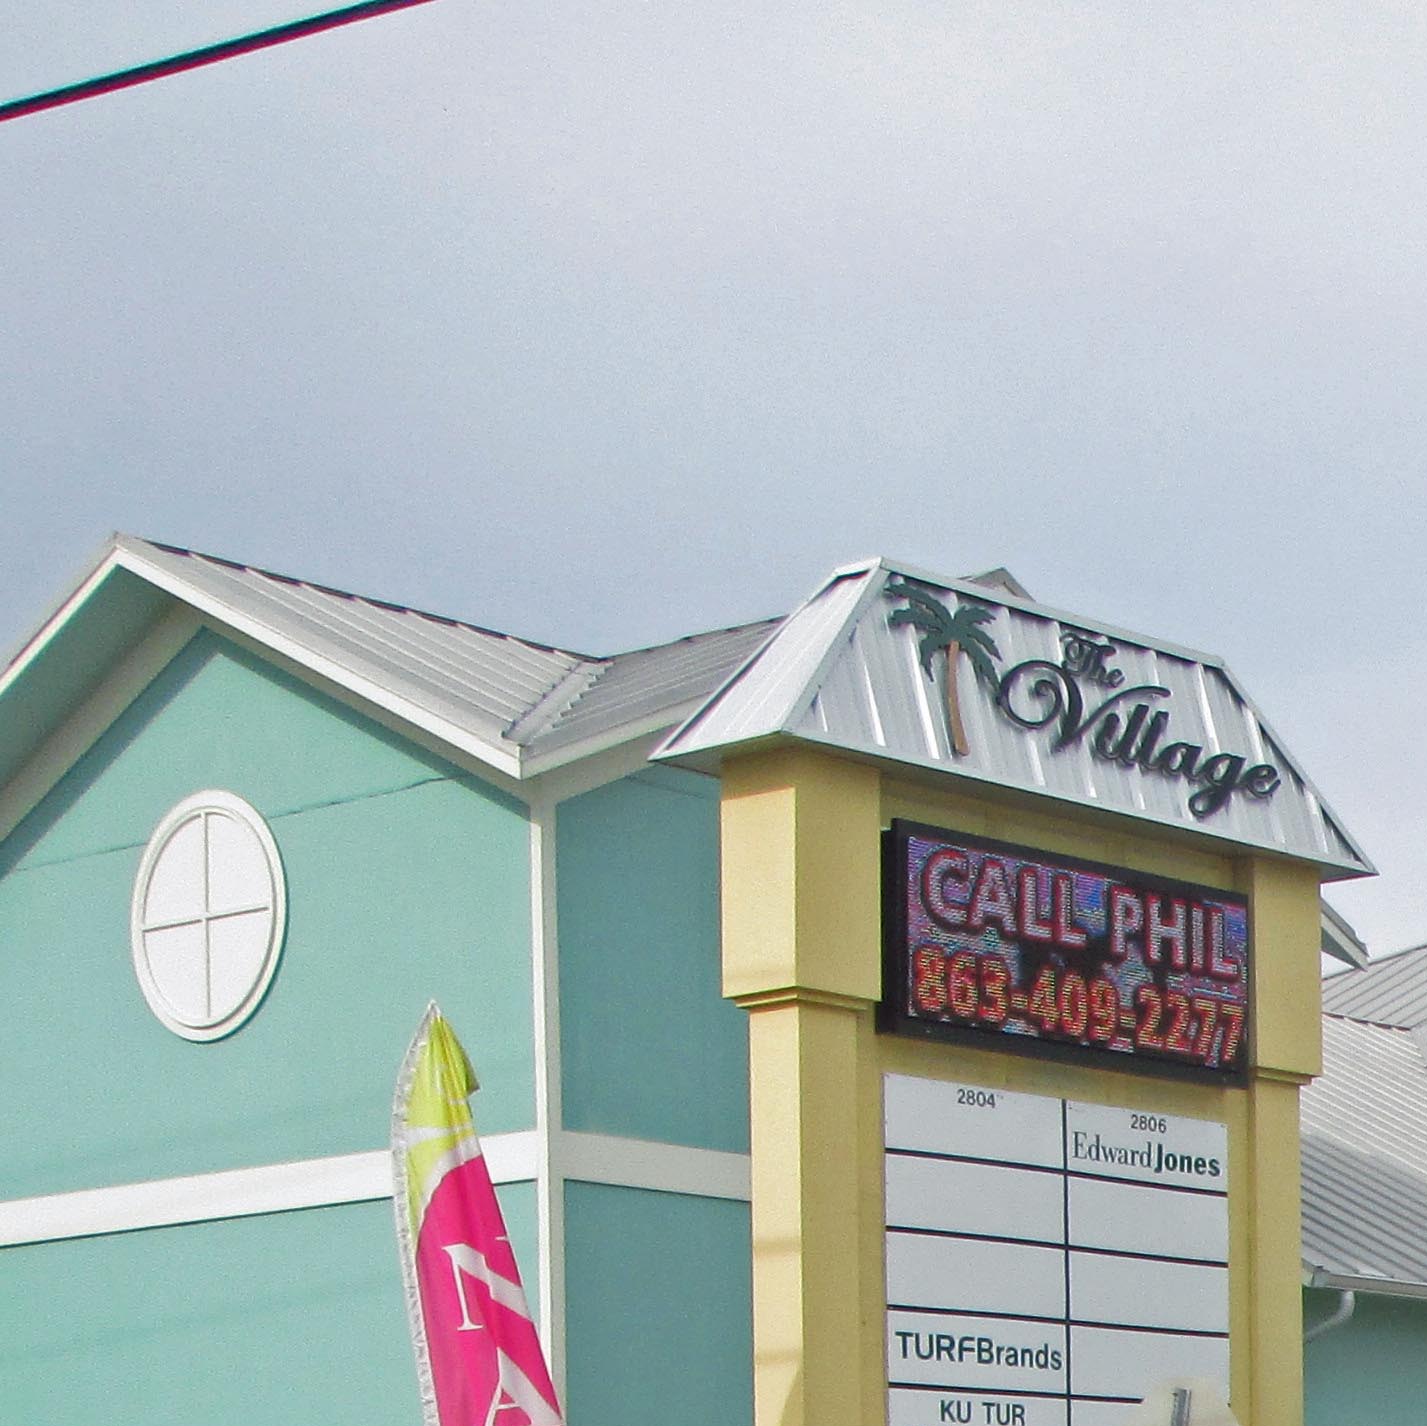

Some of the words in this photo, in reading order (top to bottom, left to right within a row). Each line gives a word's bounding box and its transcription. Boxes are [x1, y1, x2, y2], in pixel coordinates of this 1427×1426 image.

[1060, 632, 1125, 687] The
[998, 659, 1281, 817] Village
[922, 849, 1088, 947] CALL
[1111, 885, 1239, 980] PHIL
[915, 946, 1244, 1064] 863-409-2277
[956, 1088, 996, 1109] 2804
[1130, 1113, 1167, 1134] 2806
[895, 1331, 1062, 1371] TURFBrands
[940, 1400, 972, 1423] KU
[982, 1402, 1025, 1426] TUR
